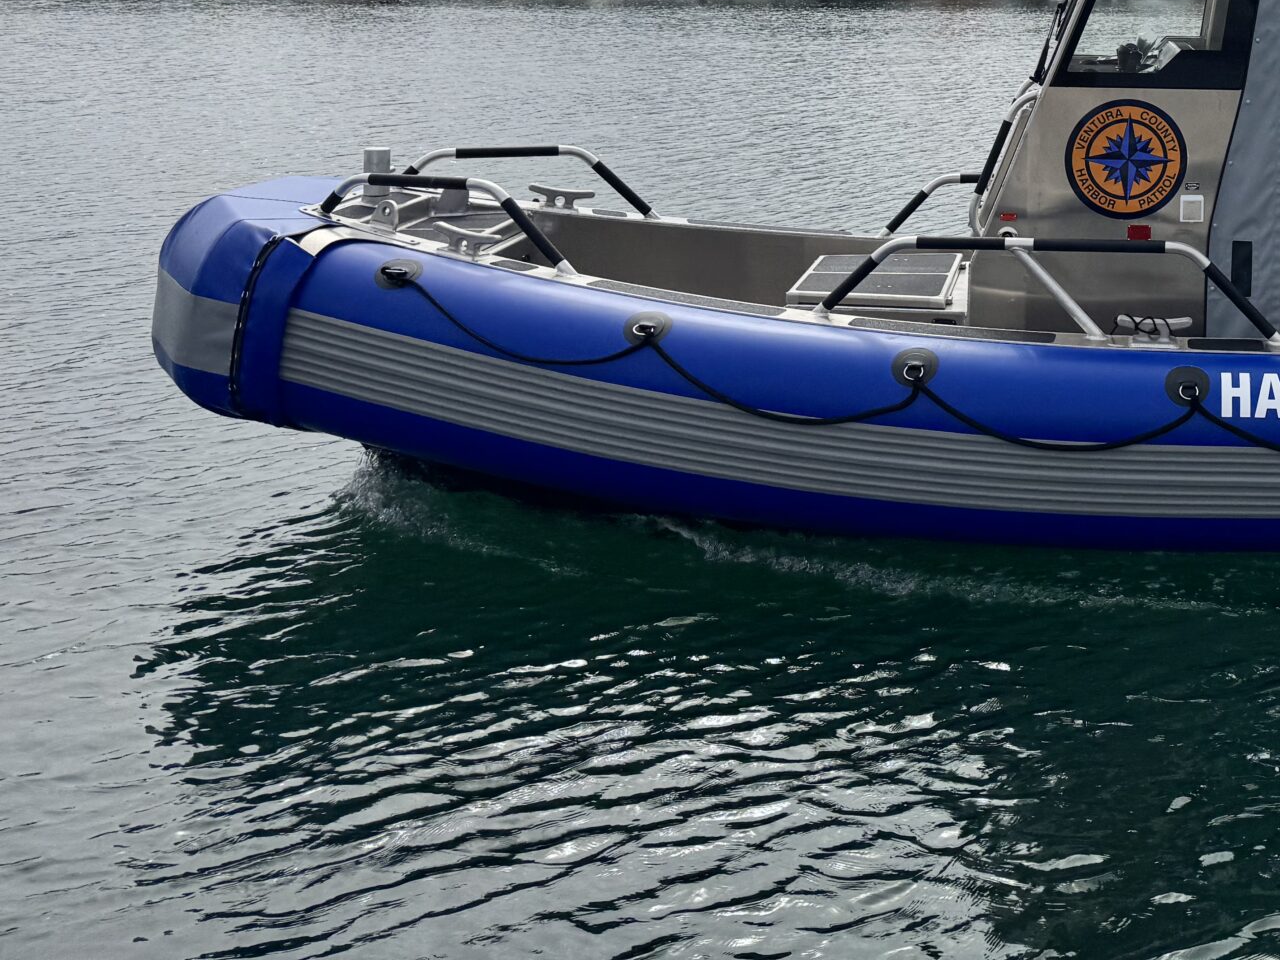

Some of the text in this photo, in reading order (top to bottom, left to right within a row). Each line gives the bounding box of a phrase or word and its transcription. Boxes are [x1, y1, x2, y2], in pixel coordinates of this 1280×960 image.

[1075, 109, 1178, 152] VENTURA COUNTY
[1076, 168, 1177, 209] HARBOR PATROL
